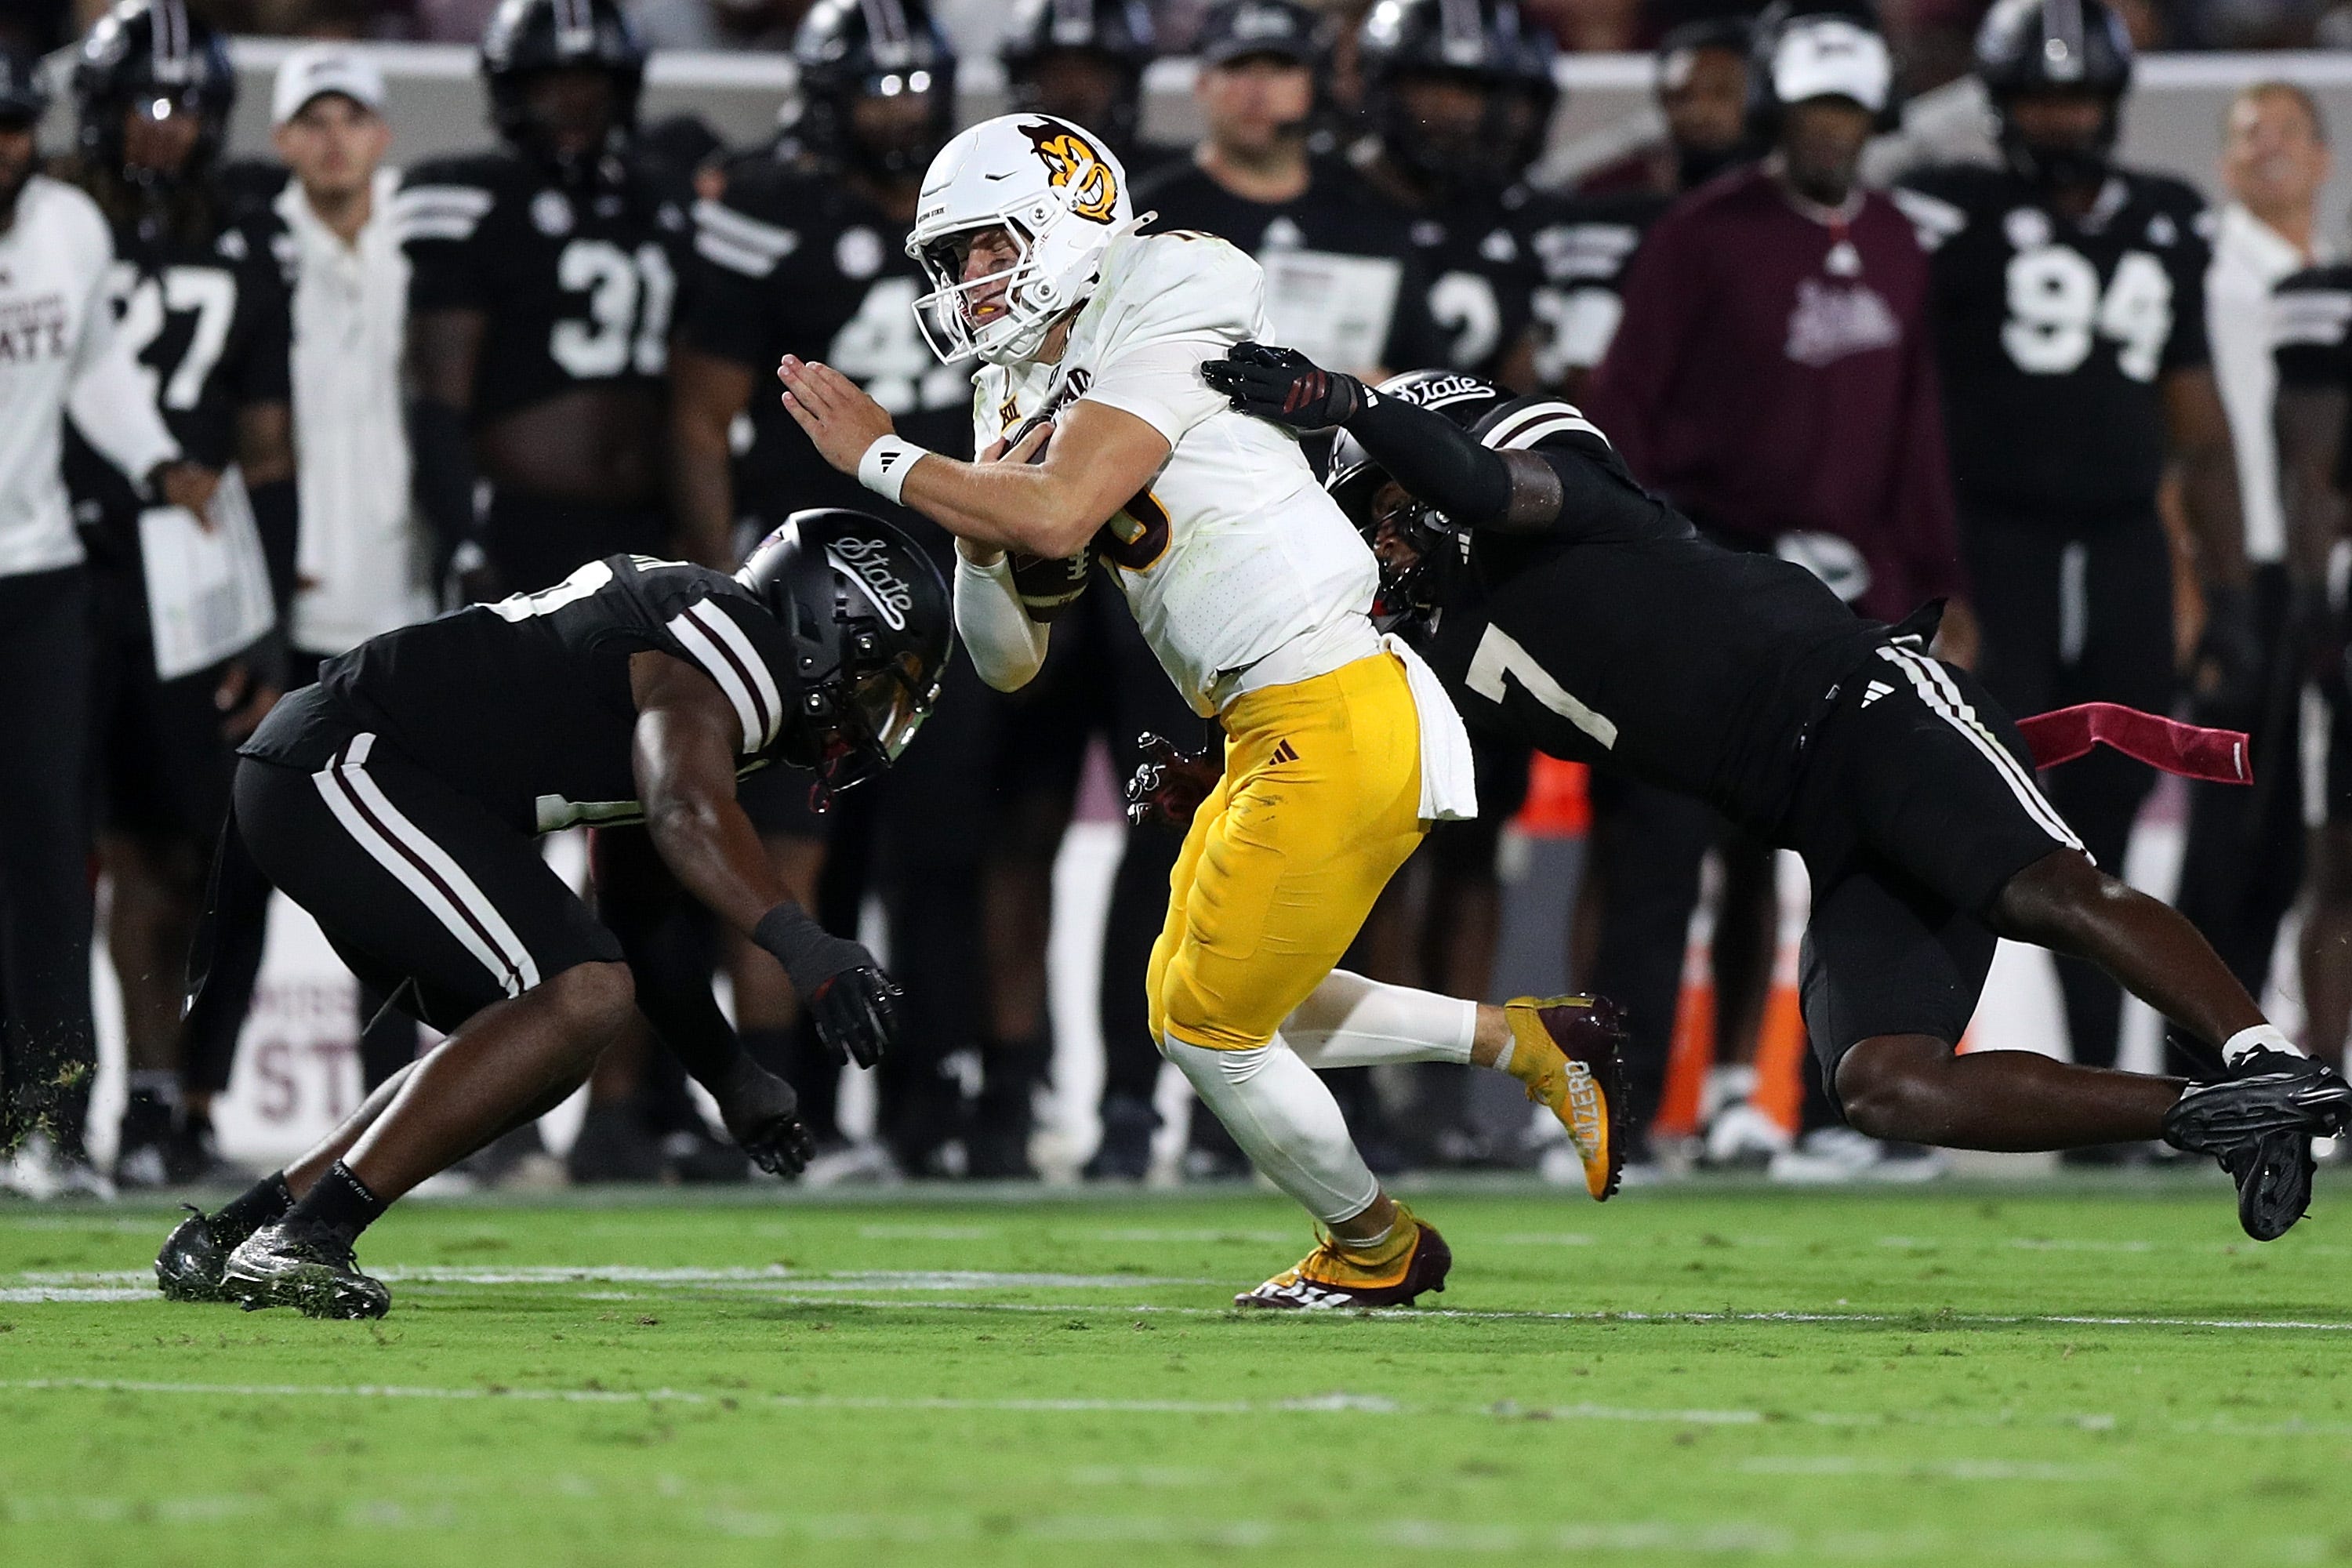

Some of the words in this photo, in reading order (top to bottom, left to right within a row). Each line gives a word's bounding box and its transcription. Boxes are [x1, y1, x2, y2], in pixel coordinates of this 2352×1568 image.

[551, 238, 677, 379] 31
[2002, 245, 2175, 383] 94
[1394, 376, 1497, 412] State
[823, 537, 913, 631] State
[1465, 622, 1618, 750] 7
